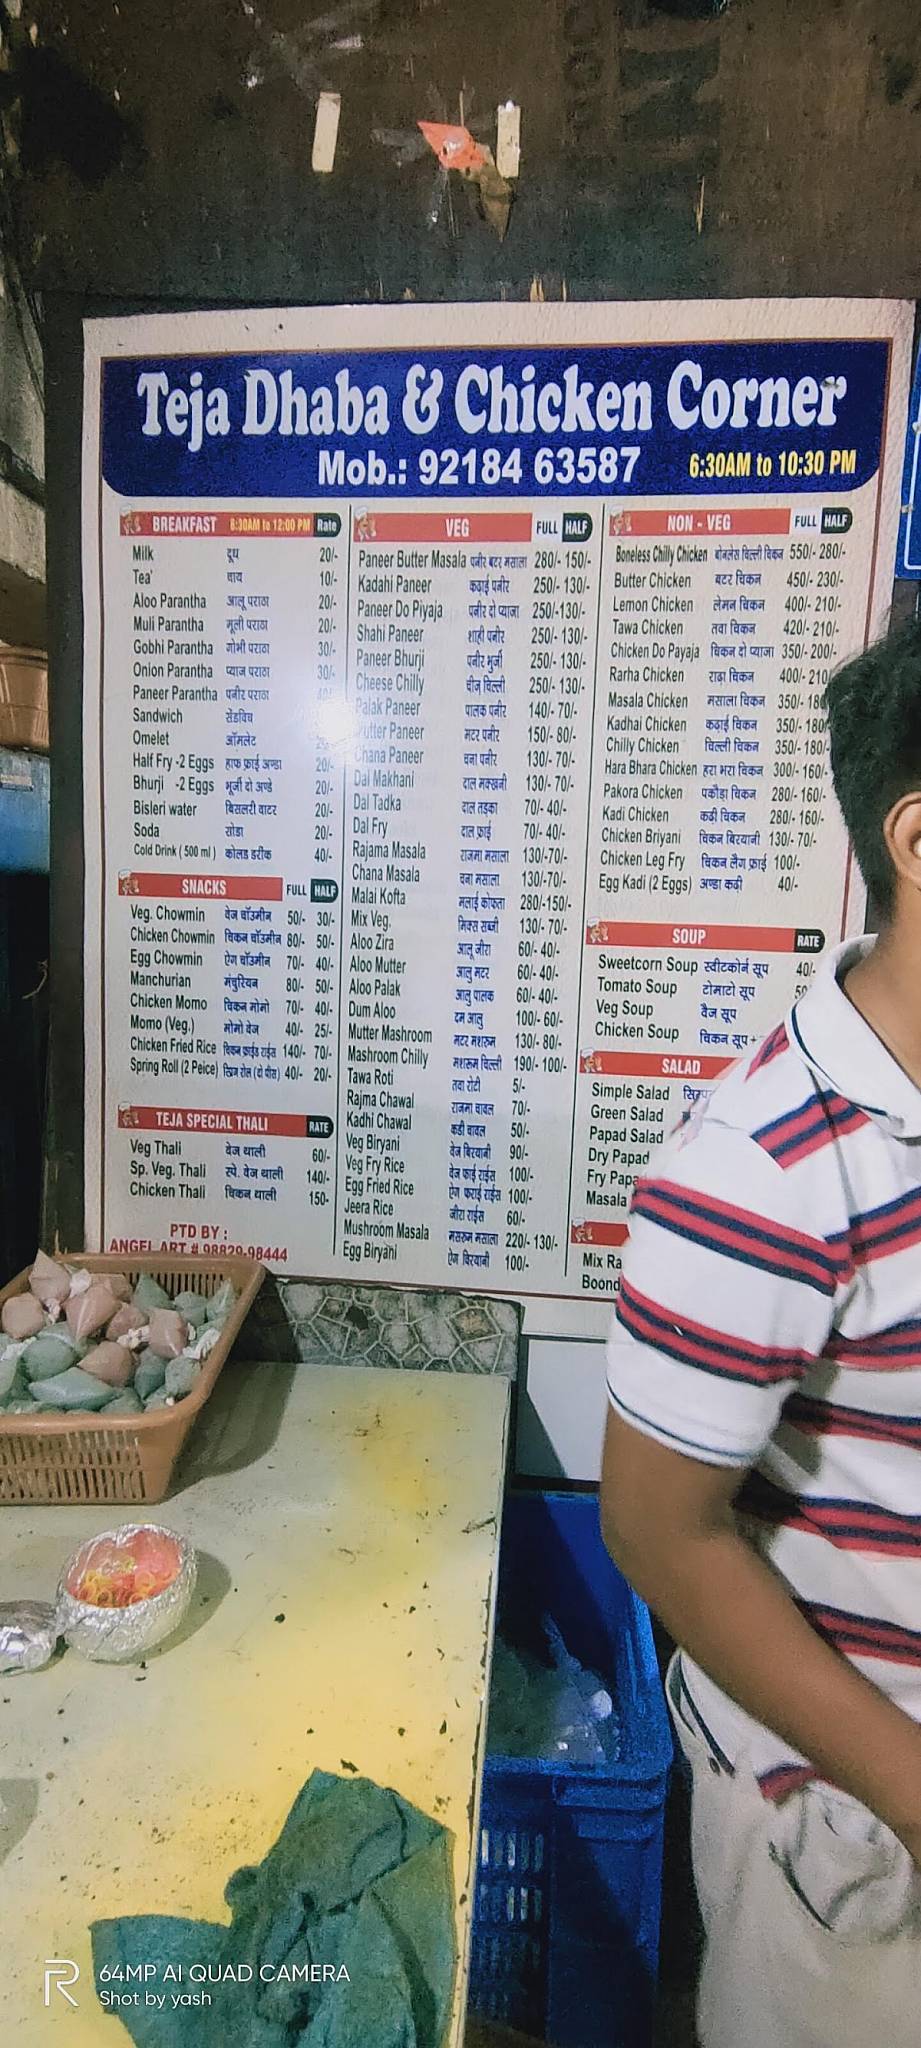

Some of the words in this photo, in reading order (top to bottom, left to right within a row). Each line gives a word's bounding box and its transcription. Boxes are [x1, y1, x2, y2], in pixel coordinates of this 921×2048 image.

[137, 372, 230, 452] Teja
[242, 368, 390, 436] Dhaba
[402, 363, 444, 435] &
[454, 362, 653, 434] Chicken
[666, 360, 848, 430] Corner
[317, 449, 407, 486] Mob.:
[418, 450, 522, 485] 92184
[534, 446, 642, 484] 63587
[690, 452, 751, 477] 6:30AM
[757, 453, 772, 476] to
[779, 452, 824, 476] 10:30
[830, 450, 856, 474] PM
[153, 516, 217, 532] BREAKFAST
[317, 518, 337, 532] Rate
[445, 519, 469, 536] VEG
[537, 521, 557, 534] FULL
[565, 519, 587, 534] HALF
[668, 516, 694, 532] NON
[707, 516, 730, 531] VEG
[795, 515, 816, 527] FULL
[824, 514, 848, 527] HALF
[133, 546, 154, 561] Milk
[320, 547, 338, 563] 20/-
[359, 550, 394, 568] Paneer
[397, 551, 428, 567] Butter
[431, 551, 466, 568] Masala
[534, 551, 561, 569] 280/-
[565, 552, 591, 569] 150/-
[359, 575, 393, 593] Kadahi
[397, 576, 432, 592] Paneer
[534, 577, 560, 593] 250/-
[565, 577, 590, 594] 130/-
[614, 572, 646, 588] Butter
[649, 572, 691, 588] Chicken
[787, 572, 812, 588] 450/-
[817, 571, 843, 588] 230/-
[133, 594, 156, 608] Aloo
[161, 594, 206, 608] Parantha
[319, 594, 337, 610] 20/-
[614, 596, 649, 612] Lemon
[652, 596, 693, 612] Chicken
[785, 595, 811, 612] 400/-
[815, 595, 841, 612] 210/-
[357, 624, 385, 642] Shahi
[389, 625, 424, 642] Paneer
[532, 628, 557, 644] 250/-
[562, 628, 587, 645] 130/-
[134, 640, 164, 654] Gobhi
[167, 640, 213, 654] Parantha
[133, 708, 182, 723] Sandwich
[607, 715, 642, 732] Kadhai
[645, 716, 687, 732] Chicken
[133, 731, 169, 745] Omelet
[604, 784, 638, 799] Pakora
[642, 784, 682, 800] Chicken
[772, 785, 797, 802] 280/-
[801, 786, 826, 803] 160/-
[134, 823, 160, 838] Soda
[315, 825, 332, 840] 20/-
[354, 817, 369, 833] Dal
[372, 818, 387, 838] Fry
[524, 823, 542, 840] 70/-
[546, 824, 565, 840] 40/-
[601, 851, 642, 867] Chicken
[646, 851, 664, 870] Leg
[668, 852, 685, 871] Fry
[774, 855, 800, 870] 100/-
[182, 880, 227, 896] SNACKS
[287, 884, 307, 896] FULL
[314, 885, 336, 897] HALF
[131, 907, 153, 922] Veg.
[156, 906, 205, 922] Chowmin
[288, 910, 306, 925] 50/-
[317, 912, 335, 927] 30/-
[351, 910, 367, 927] Mix
[371, 912, 391, 930] Veg.
[520, 919, 544, 935] 130/-
[548, 920, 567, 935] 70/-
[351, 934, 373, 950] Aloo
[376, 935, 394, 950] Zira
[672, 927, 706, 945] SOUP
[798, 935, 820, 947] RATE
[519, 941, 537, 957] 60/-
[541, 943, 560, 958] 40/-
[599, 954, 662, 971] Sweetcorn
[666, 957, 698, 975] Soup
[796, 961, 816, 976] 40/-
[131, 971, 191, 988] Manchurian
[287, 978, 304, 993] 80/-
[316, 980, 333, 995] 50/-
[598, 977, 641, 993] Tomato
[645, 978, 677, 997] Soup
[131, 993, 172, 1009] Chicken
[176, 994, 207, 1010] Momo
[597, 1000, 618, 1017] Veg
[622, 1001, 653, 1018] Soup
[348, 1024, 379, 1042] Mutter
[382, 1027, 432, 1043] Mashroom
[595, 1022, 644, 1039] Chicken
[647, 1023, 679, 1041] Soup
[516, 1034, 539, 1049] 130/-
[543, 1035, 561, 1050] 80/-
[663, 1059, 701, 1075] SALAD
[348, 1067, 370, 1085] Tawa
[375, 1069, 393, 1085] Roti
[513, 1078, 525, 1094] 5/-
[592, 1082, 632, 1101] Simple
[636, 1083, 669, 1101] Salad
[591, 1105, 626, 1120] Green
[630, 1107, 664, 1122] Salad
[156, 1112, 183, 1127] TEJA
[187, 1113, 232, 1129] SPECIAL
[236, 1115, 267, 1131] THALI
[310, 1122, 329, 1133] RATE
[130, 1139, 150, 1156] Veg
[155, 1140, 181, 1155] Thali
[346, 1133, 363, 1150] Veg
[366, 1135, 399, 1154] Biryani
[510, 1144, 528, 1160] 90/-
[312, 1148, 330, 1163] 60/-
[589, 1148, 608, 1165] Dry
[613, 1150, 649, 1167] Papad
[130, 1182, 175, 1198] Chicken
[178, 1183, 205, 1199] Thali
[344, 1198, 370, 1215] Jeera
[373, 1199, 393, 1216] Rice
[507, 1208, 525, 1225] 60/-
[170, 1224, 196, 1238] PTD
[201, 1225, 220, 1239] BY
